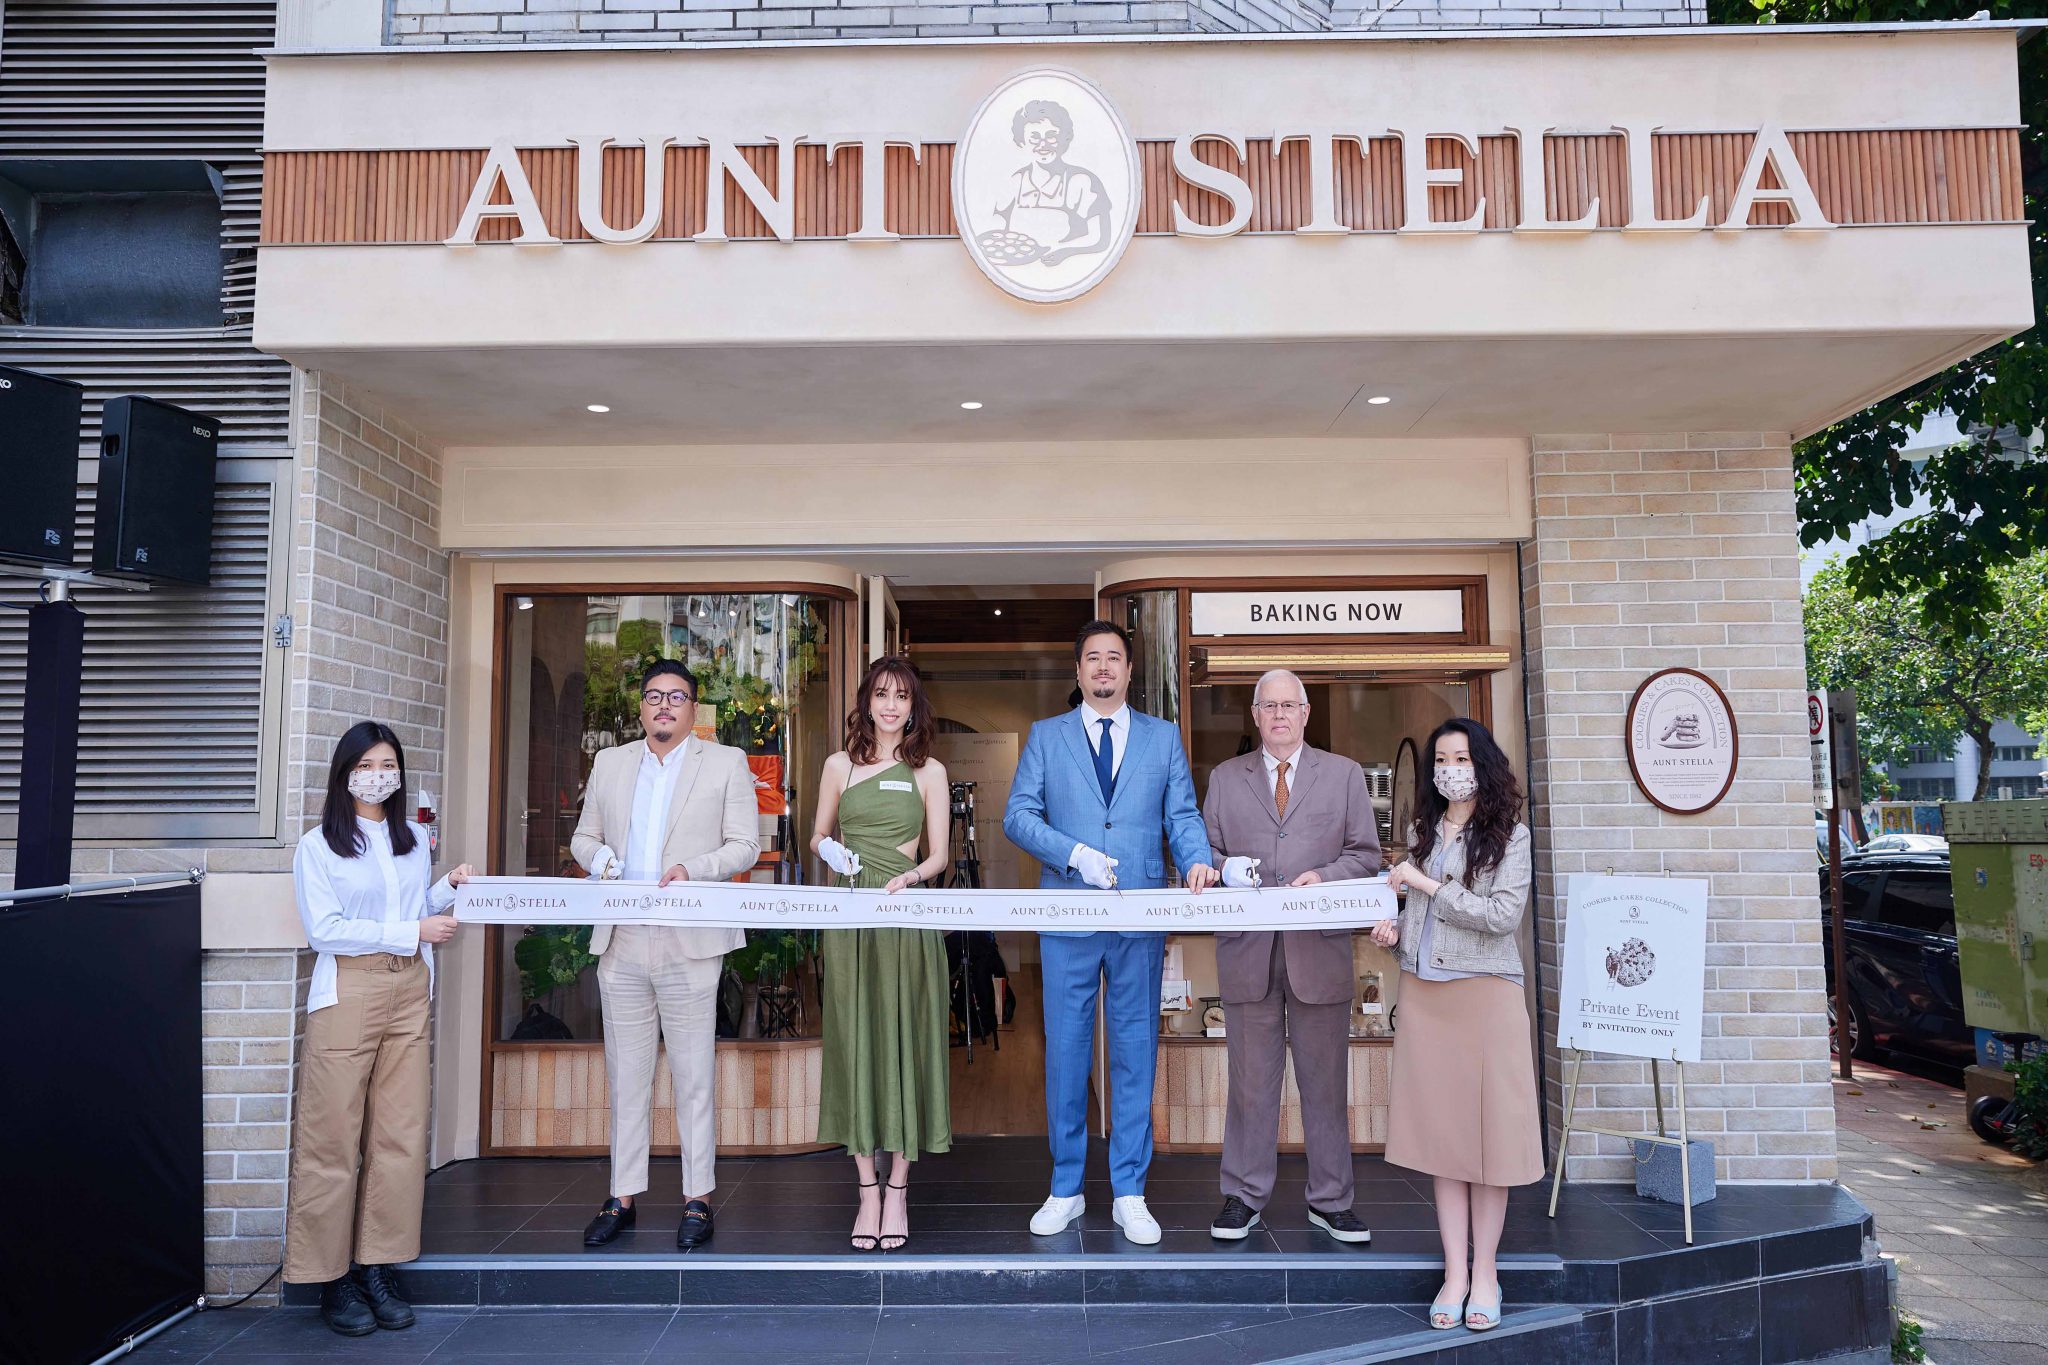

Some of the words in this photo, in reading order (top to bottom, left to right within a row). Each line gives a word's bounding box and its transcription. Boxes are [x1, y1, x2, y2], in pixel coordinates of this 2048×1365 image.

[443, 133, 922, 247] AUNT
[1172, 124, 1838, 237] STELLA
[193, 426, 211, 438] NEXO
[1250, 603, 1337, 622] BAKING
[1348, 603, 1403, 621] NOW
[1636, 700, 1650, 749] COOKIES
[1654, 677, 1691, 691] CAKES
[1693, 682, 1728, 748] COLLECTION
[1652, 759, 1677, 767] AUNT
[1679, 758, 1714, 766] STELLA
[467, 897, 505, 908] AUNT
[519, 898, 567, 908] STELLA
[603, 898, 639, 908] AUNT
[654, 898, 702, 908] STELLA
[739, 901, 776, 911] AUNT
[791, 903, 839, 913] STELLA
[1281, 900, 1316, 911] AUNT
[1333, 898, 1382, 909] STELLA
[1582, 896, 1611, 909] COOKIES
[1645, 895, 1688, 915] COLLECTION
[875, 904, 911, 913] AUNT
[926, 906, 974, 915] STELLA
[1010, 907, 1045, 916] AUNT
[1061, 907, 1109, 916] STELLA
[1145, 907, 1180, 916] AUNT
[1196, 904, 1245, 915] STELLA
[1580, 998, 1630, 1016] Private
[1636, 1003, 1680, 1021] Event
[1582, 1021, 1593, 1029] BY
[1597, 1022, 1647, 1034] INVITATION
[1651, 1028, 1675, 1037] ONLY
